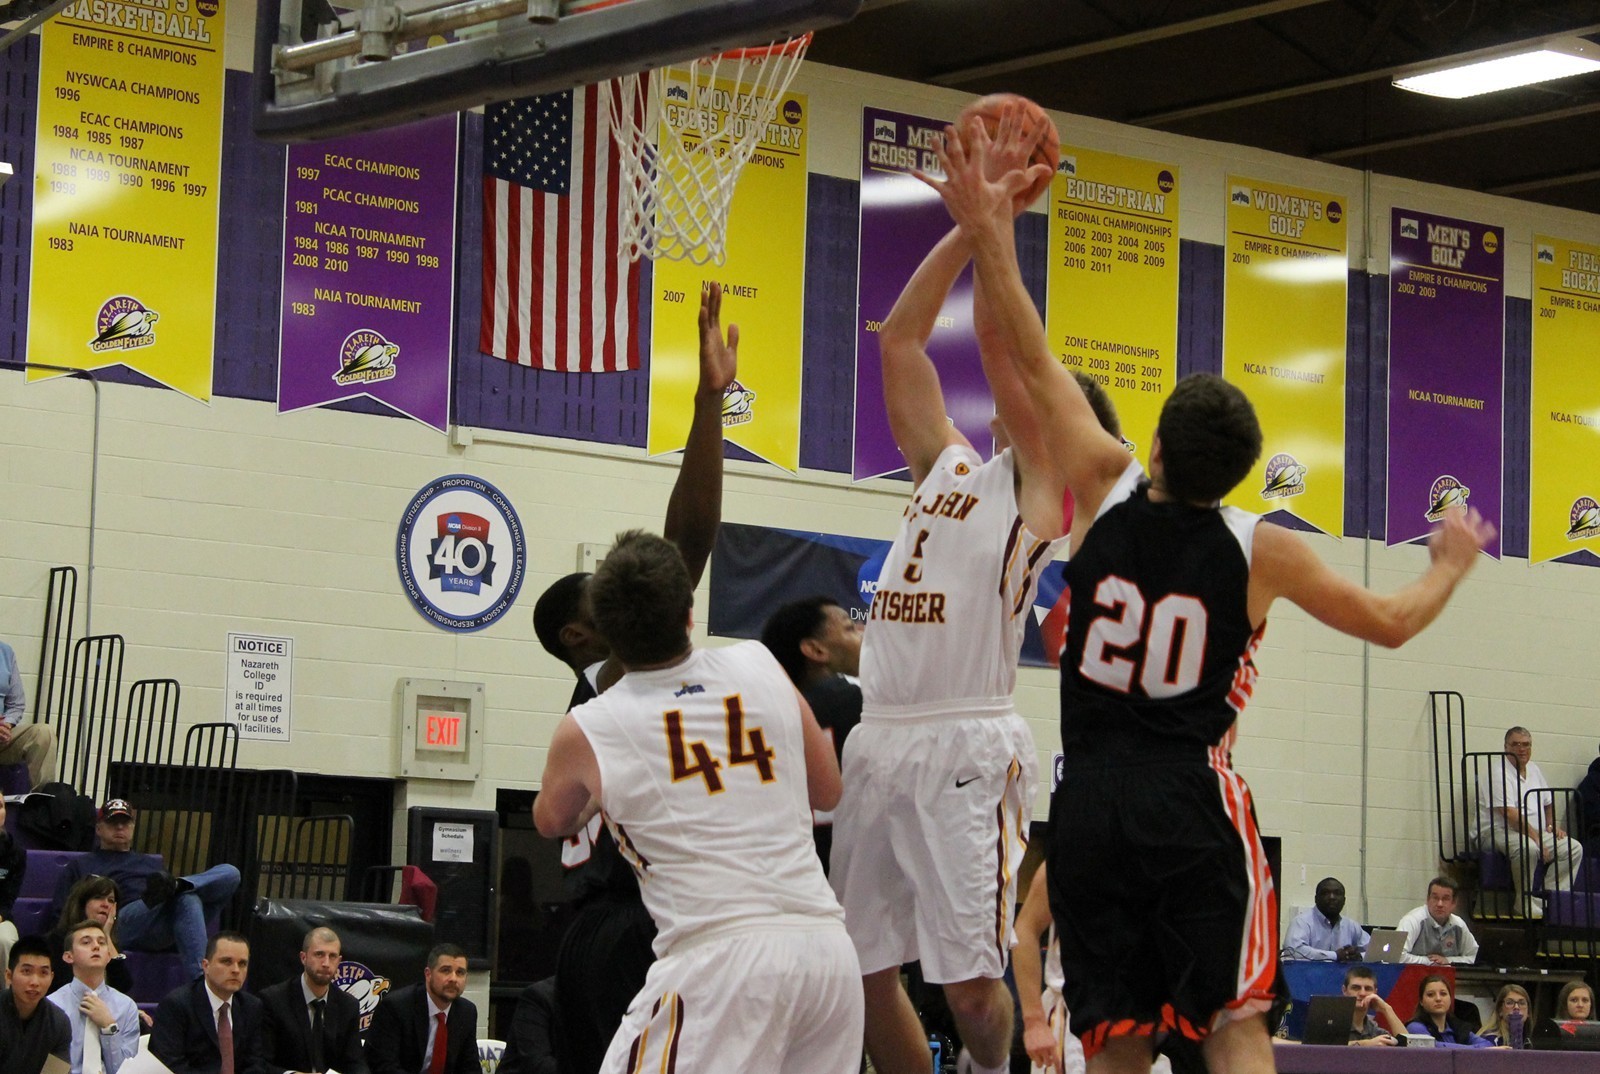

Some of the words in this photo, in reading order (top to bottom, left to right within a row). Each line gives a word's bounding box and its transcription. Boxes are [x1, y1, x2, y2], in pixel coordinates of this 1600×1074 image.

[61, 0, 210, 43] BASKETBALL
[72, 33, 114, 52] EMPIRE
[117, 41, 125, 53] 8
[127, 43, 197, 66] CHAMPIONS
[54, 87, 81, 101] 1996
[66, 70, 127, 92] NYSWCAA
[130, 82, 200, 104] CHAMPIONS
[80, 111, 110, 127] ECAC
[114, 117, 183, 139] CHAMPIONS
[53, 125, 79, 139] 1984
[86, 131, 112, 145] 1985
[119, 136, 144, 150] 1987
[70, 147, 104, 164] NCAA
[108, 153, 190, 178] TOURNAMENT
[719, 147, 726, 156] 8
[869, 141, 917, 170] CROSS
[296, 167, 320, 181] 1997
[324, 154, 352, 169] ECAC
[355, 159, 420, 180] CHAMPIONS
[50, 180, 76, 195] 1998
[51, 162, 77, 177] 1988
[86, 168, 110, 182] 1989
[118, 173, 143, 187] 1990
[150, 178, 176, 193] 1996
[182, 183, 207, 197] 1997
[323, 187, 351, 203] PCAC
[354, 193, 419, 213] CHAMPIONS
[1066, 177, 1166, 214] EQUESTRIAN
[1252, 189, 1322, 220] WOMEN'S
[295, 201, 318, 214] 1981
[1058, 208, 1100, 225] REGIONAL
[1103, 217, 1172, 238] CHAMPIONSHIPS
[1269, 214, 1305, 238] GOLF
[48, 237, 74, 251] 1983
[69, 222, 99, 238] NAIA
[103, 227, 185, 250] TOURNAMENT
[315, 222, 346, 237] NCAA
[350, 227, 425, 249] TOURNAMENT
[1065, 226, 1086, 239] 2002
[1091, 231, 1112, 243] 2003
[1118, 236, 1139, 248] 2004
[1144, 240, 1165, 252] 2005
[1427, 223, 1470, 249] MEN'S
[294, 236, 318, 250] 1984
[325, 241, 349, 255] 1986
[356, 246, 379, 259] 1987
[386, 250, 409, 264] 1990
[416, 254, 439, 268] 1998
[1064, 241, 1085, 254] 2006
[1091, 246, 1112, 258] 2007
[1117, 251, 1138, 263] 2008
[1144, 255, 1165, 267] 2009
[1232, 253, 1250, 264] 2010
[1244, 240, 1272, 254] EMPIRE
[1274, 246, 1280, 255] 8
[1431, 247, 1465, 269] GOLF
[293, 253, 318, 268] 2008
[324, 258, 348, 272] 2010
[1064, 256, 1085, 269] 2010
[1090, 261, 1111, 273] 2011
[1569, 249, 1600, 273] FIEL
[702, 280, 730, 294] NA
[733, 285, 758, 298] MEET
[1398, 282, 1415, 295] 2002
[1419, 286, 1436, 298] 2003
[1409, 271, 1435, 283] EMPIRE
[1436, 276, 1442, 285] 8
[1443, 277, 1487, 293] CHAMPIONS
[1562, 268, 1600, 294] HOCK
[314, 288, 342, 303] NAIA
[346, 292, 421, 313] TOURNAMENT
[663, 290, 685, 303] 2007
[1550, 296, 1575, 309] EMPIRE
[1576, 300, 1582, 309] 8
[100, 299, 139, 333] NAZARETH
[292, 302, 315, 316] 1983
[1540, 308, 1556, 319] 2007
[866, 320, 884, 332] 200
[344, 334, 380, 366] NAZARETH
[1065, 336, 1088, 349] ZONE
[1090, 340, 1160, 360] CHAMPIONSHIPS
[1062, 354, 1083, 366] 2002
[1088, 358, 1110, 370] 2003
[1115, 362, 1136, 374] 2005
[1141, 366, 1162, 378] 2007
[1244, 363, 1267, 375] NCAA
[1270, 366, 1325, 384] TOURNAMENT
[1115, 377, 1136, 389] 2010
[1141, 381, 1162, 393] 2011
[1408, 389, 1431, 402] NCAA
[1433, 392, 1484, 410] TOURNAMENT
[1550, 411, 1571, 423] NCAA
[442, 479, 486, 492] PROPORTION
[406, 487, 434, 525] CITIZENSHIP
[492, 493, 523, 552] COMPREHENSIVE
[400, 533, 419, 600] SPORTSMANSHIP
[434, 535, 487, 577] 40
[448, 578, 474, 587] YEARS
[509, 554, 523, 594] LEARNING
[860, 581, 879, 593] NC
[423, 605, 475, 628] RESPONSIBILITY
[482, 600, 507, 623] PASSION
[851, 607, 869, 621] Divi
[871, 590, 946, 624] FISHER
[238, 640, 283, 653] NOTICE
[1078, 574, 1209, 699] 20
[241, 659, 279, 670] Nazareth
[243, 670, 276, 682] College
[235, 690, 243, 699] is
[245, 692, 282, 702] required
[254, 681, 264, 690] ID
[235, 702, 243, 710] at
[245, 702, 256, 711] all
[258, 703, 282, 712] times
[238, 712, 250, 721] for
[252, 714, 268, 722] use
[270, 714, 279, 723] of
[244, 723, 284, 734] facilities.
[426, 715, 460, 746] EXIT
[663, 692, 776, 796] 44
